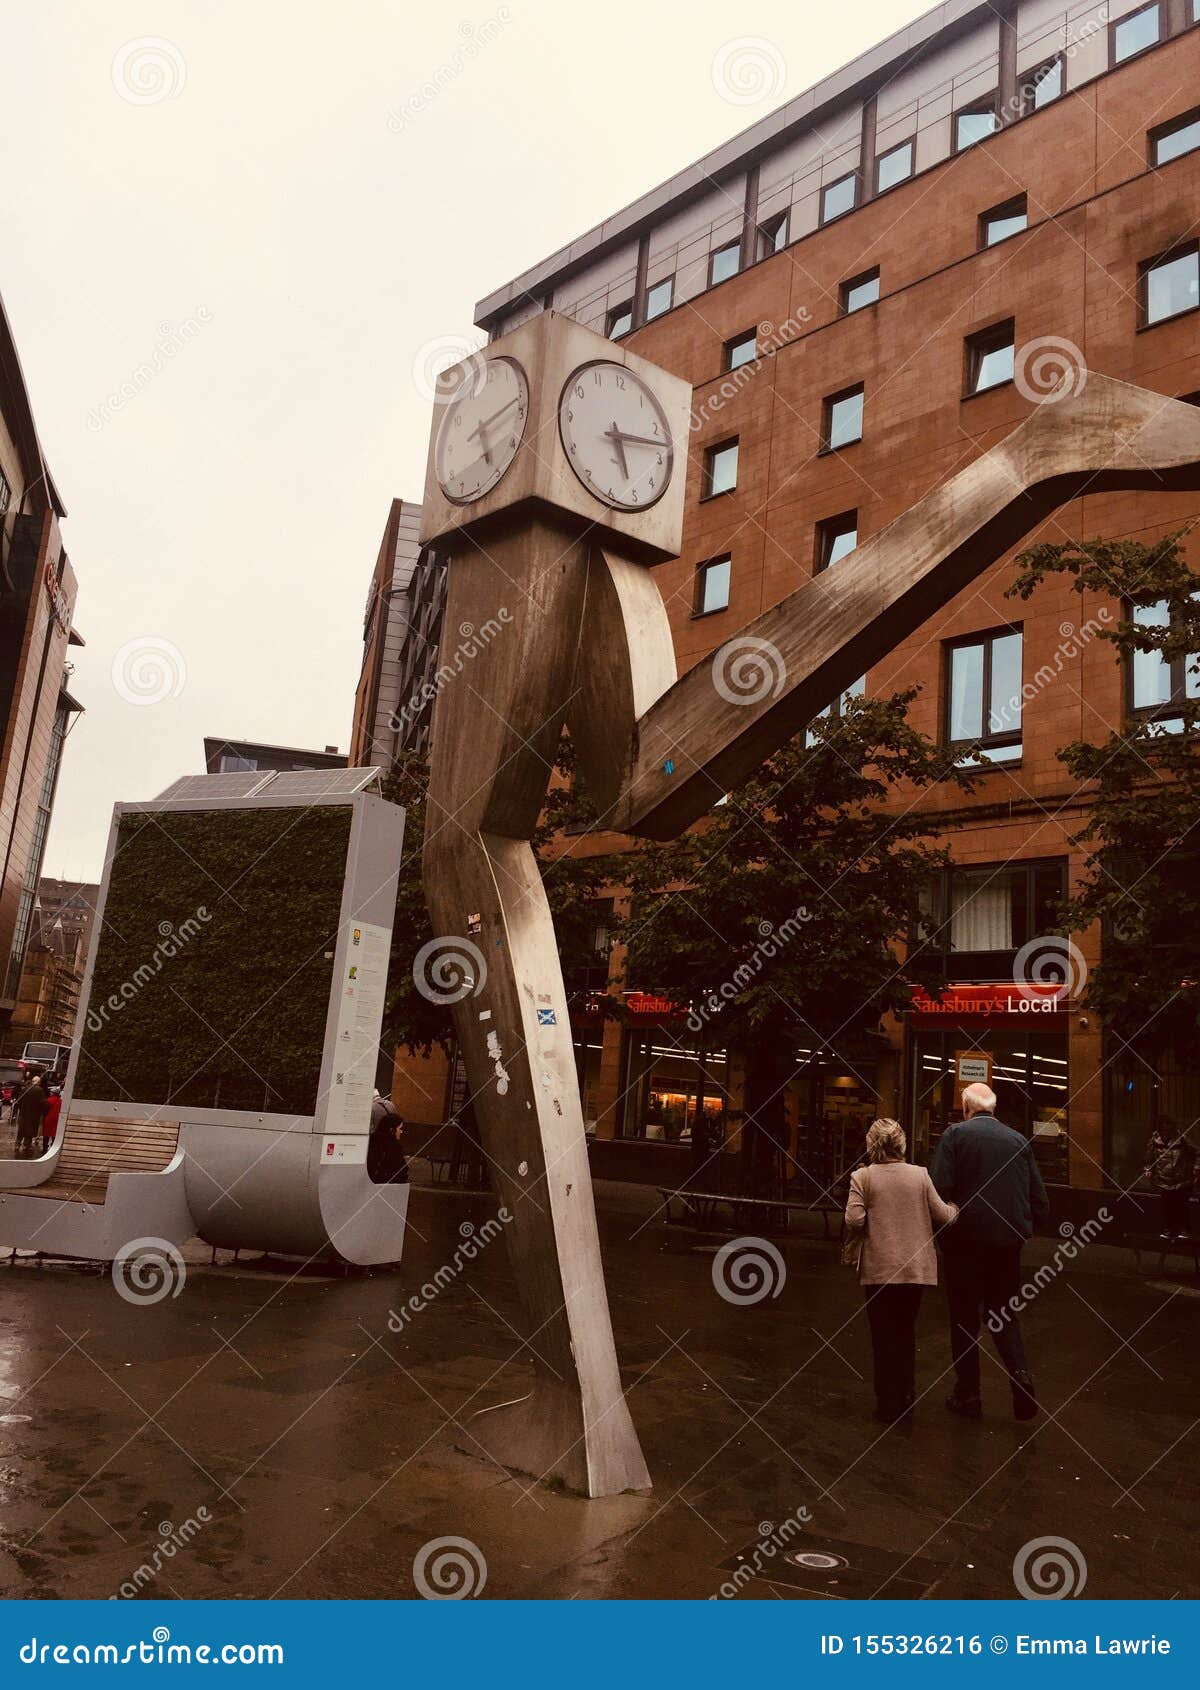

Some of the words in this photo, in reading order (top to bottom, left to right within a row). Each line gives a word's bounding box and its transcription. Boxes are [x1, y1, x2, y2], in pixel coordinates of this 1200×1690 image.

[593, 371, 602, 387] 11
[615, 374, 626, 391] 12
[652, 422, 659, 435] 2
[656, 451, 663, 465] 3
[648, 476, 656, 489] 4
[631, 489, 638, 503] 5
[1007, 995, 1057, 1013] Local
